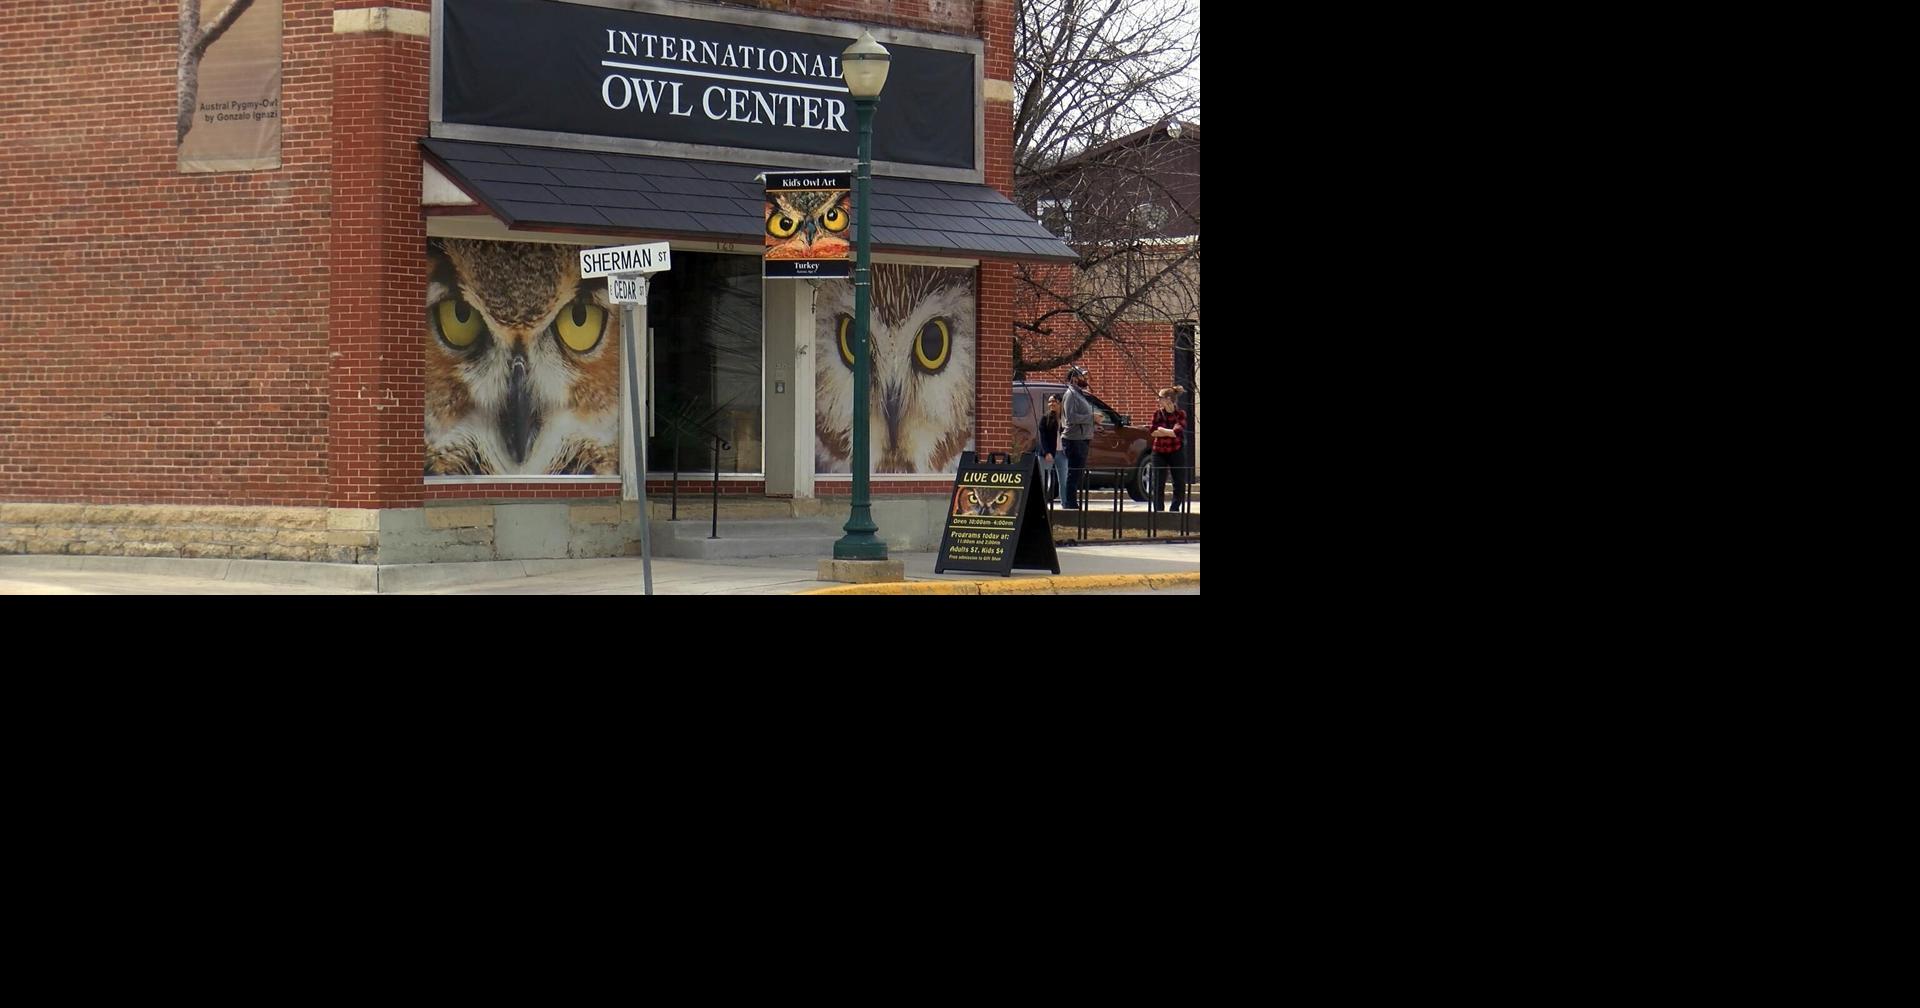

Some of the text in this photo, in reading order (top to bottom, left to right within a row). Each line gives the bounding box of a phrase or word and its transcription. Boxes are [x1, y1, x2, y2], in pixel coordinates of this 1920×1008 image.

[606, 29, 844, 79] INTERNATIONAL
[200, 98, 278, 112] Austral Pygmy-Owl
[601, 74, 849, 132] OWL CENTER
[205, 114, 214, 123] by
[216, 111, 251, 121] Gonzalo
[782, 178, 836, 187] Kid's Owl Art
[583, 248, 667, 273] SHERMAN ST
[794, 261, 819, 272] Turkey
[613, 280, 637, 300] CEDAR
[639, 285, 645, 296] ST
[963, 472, 1022, 483] LIVE OWLS
[951, 531, 981, 539] Programs
[982, 532, 999, 540] today
[950, 545, 969, 553] Adults
